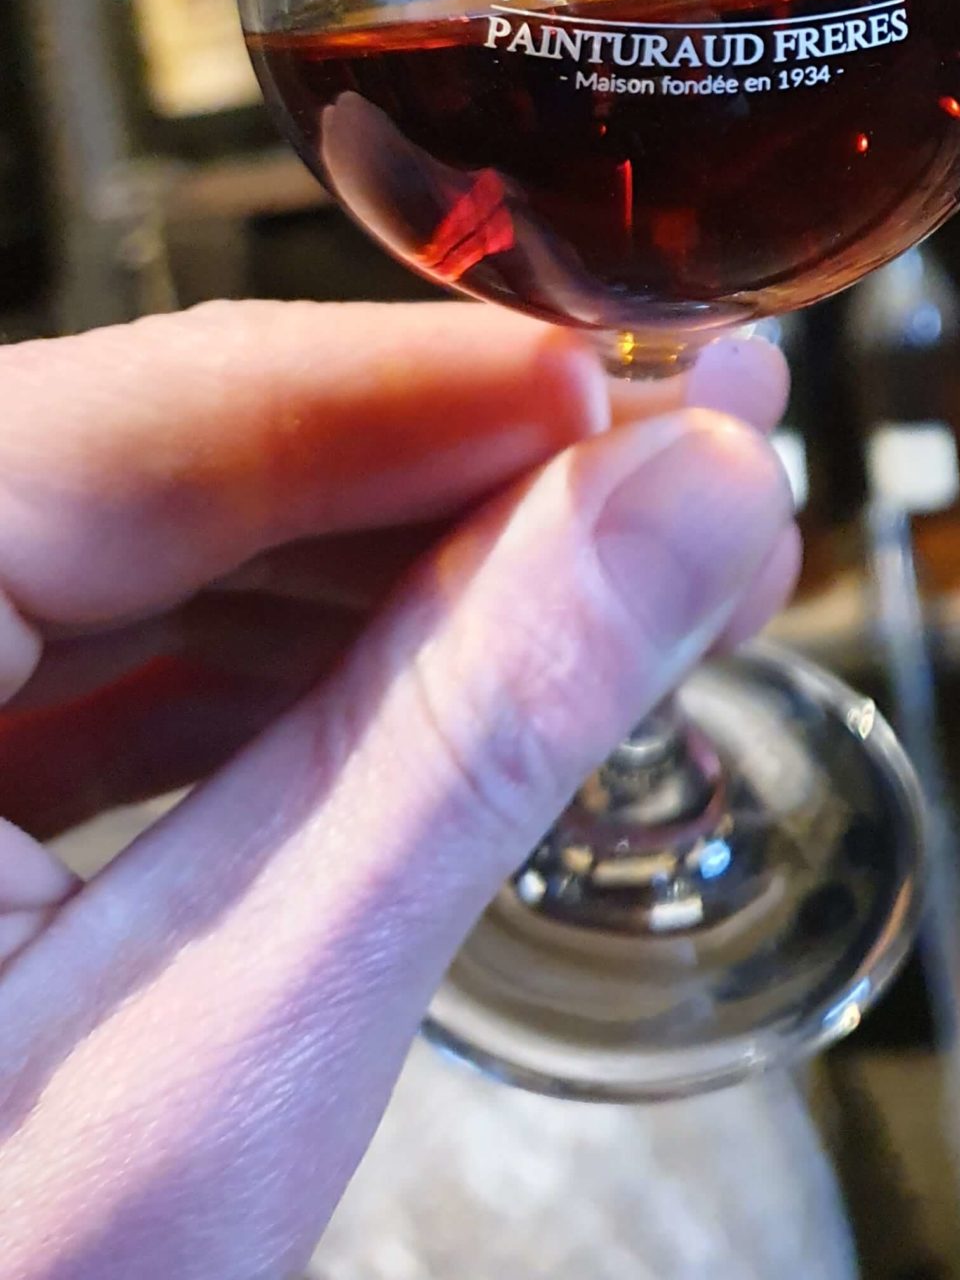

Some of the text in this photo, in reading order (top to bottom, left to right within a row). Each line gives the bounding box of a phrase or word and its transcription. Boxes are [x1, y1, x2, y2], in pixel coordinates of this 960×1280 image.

[483, 8, 908, 67] PAINTURAUD FRERES
[575, 71, 655, 95] Maison
[662, 73, 738, 95] fondée
[745, 75, 771, 93] en
[778, 65, 830, 90] 1934
